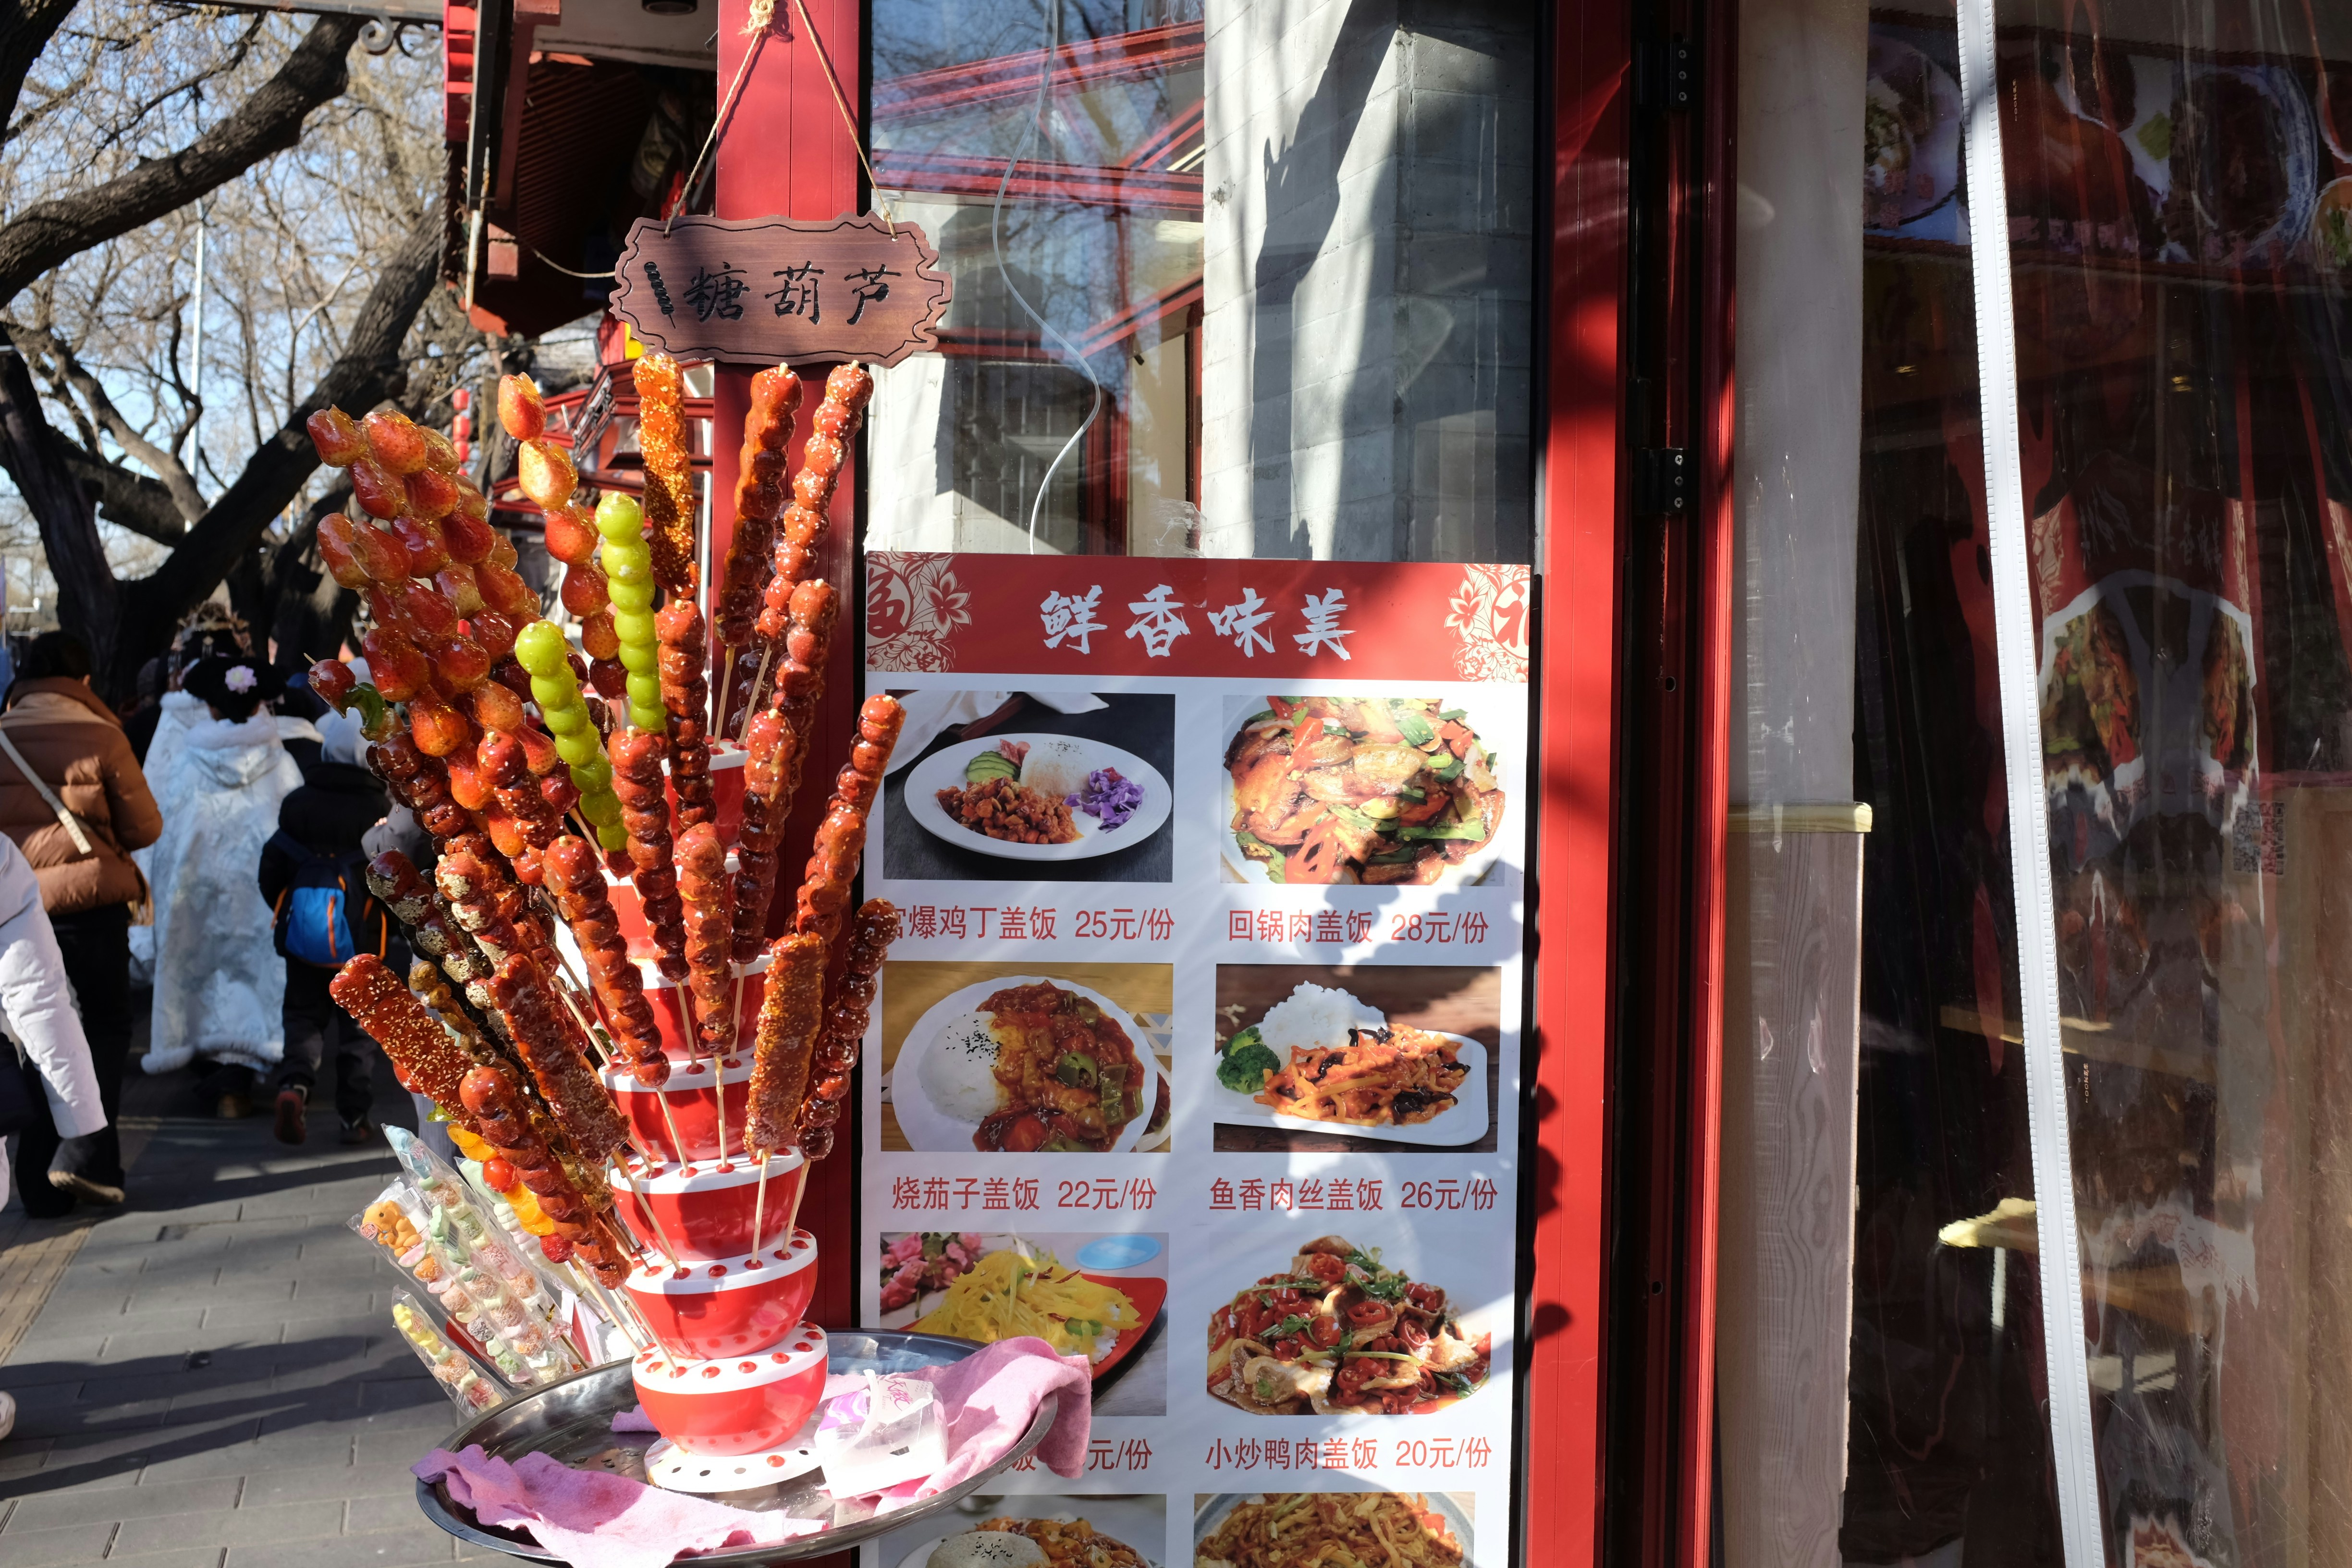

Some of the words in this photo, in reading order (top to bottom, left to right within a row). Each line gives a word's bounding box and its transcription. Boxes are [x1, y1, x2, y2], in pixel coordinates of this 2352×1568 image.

[683, 261, 902, 325] 糖葫芦
[1040, 584, 1356, 661] 鲜香味美
[1075, 907, 1175, 941] 25元/份
[1229, 909, 1372, 943] 回锅肉盖饭
[1391, 911, 1489, 944] 28元/份
[892, 1176, 1040, 1210] 烧茄子盖饭
[1057, 1178, 1157, 1210] 22元/份
[1209, 1177, 1384, 1211] 鱼香肉丝盖饭
[1401, 1178, 1498, 1210] 26元/份
[1205, 1437, 1378, 1470] 小炒鸭肉盖饭
[1396, 1437, 1492, 1469] 20元/份
